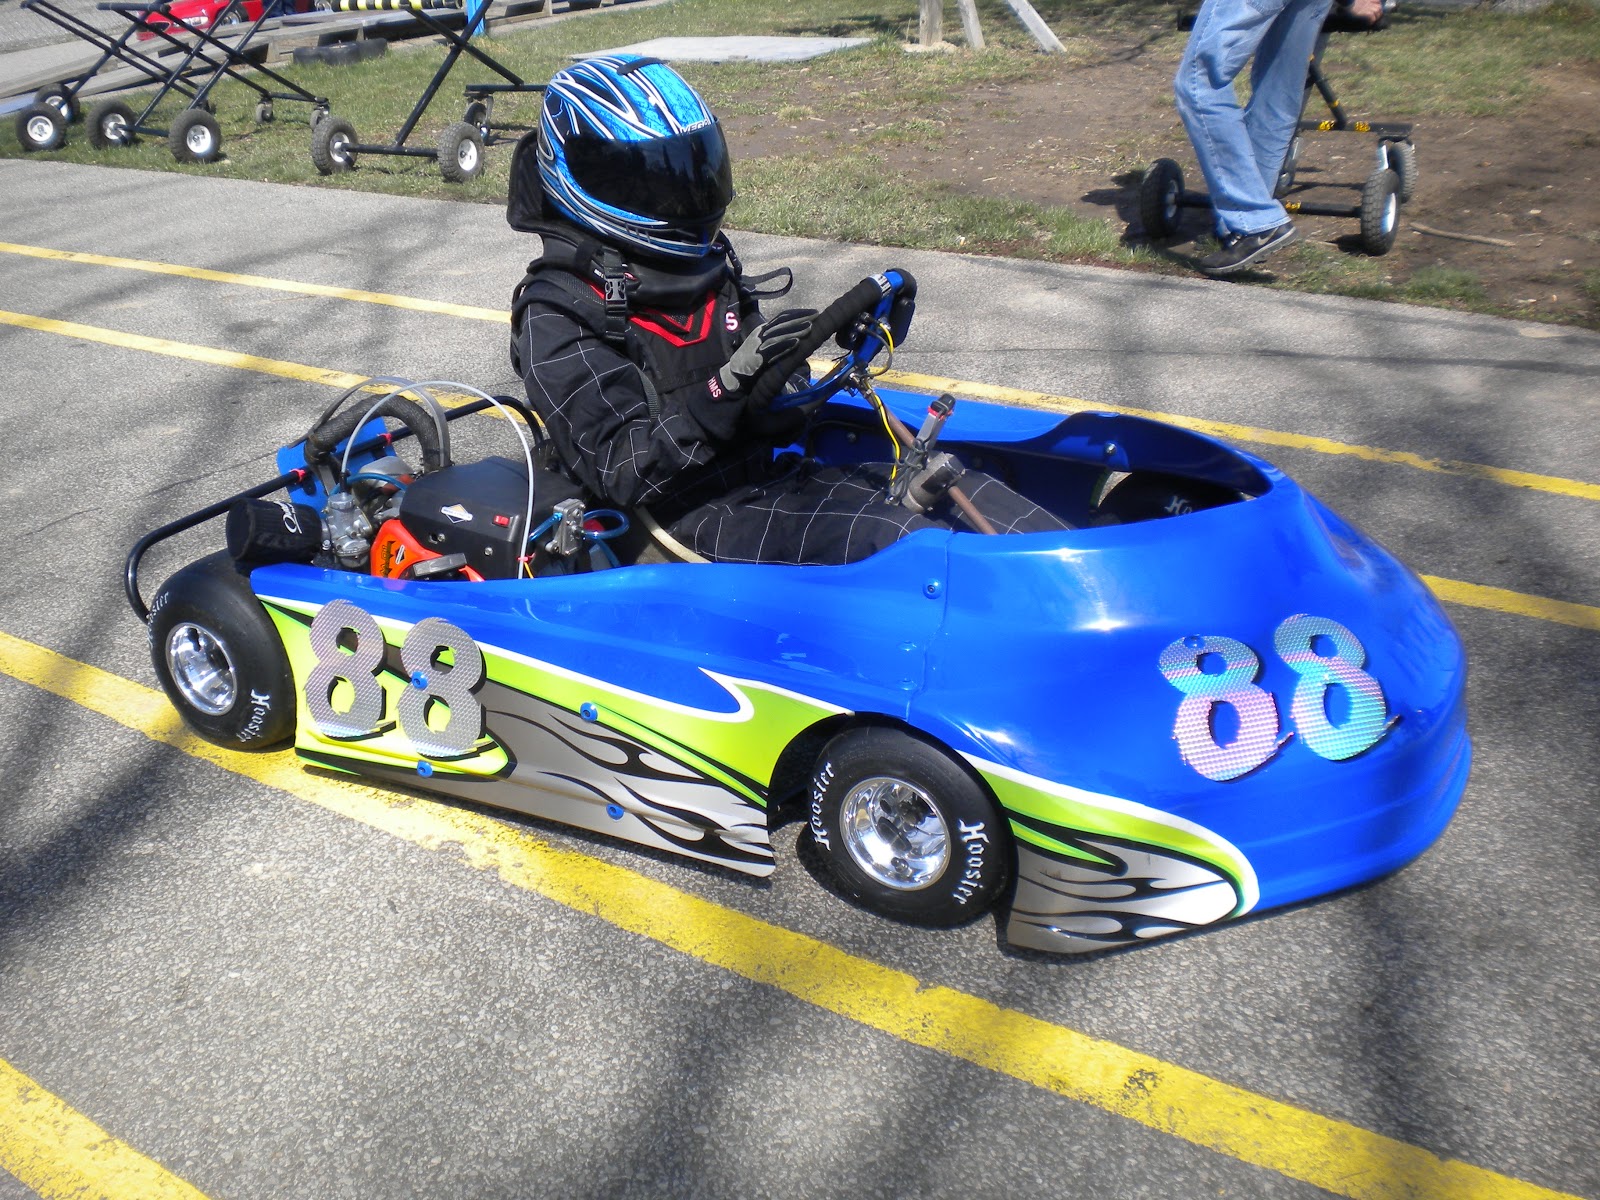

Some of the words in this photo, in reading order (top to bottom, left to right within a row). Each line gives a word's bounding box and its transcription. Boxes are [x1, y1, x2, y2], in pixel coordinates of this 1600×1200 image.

[680, 118, 711, 135] VEGA
[236, 688, 271, 742] Hoosier
[304, 599, 486, 758] 88
[1157, 612, 1399, 783] 88
[811, 761, 836, 851] Hoosier
[953, 818, 990, 905] Hoosier
